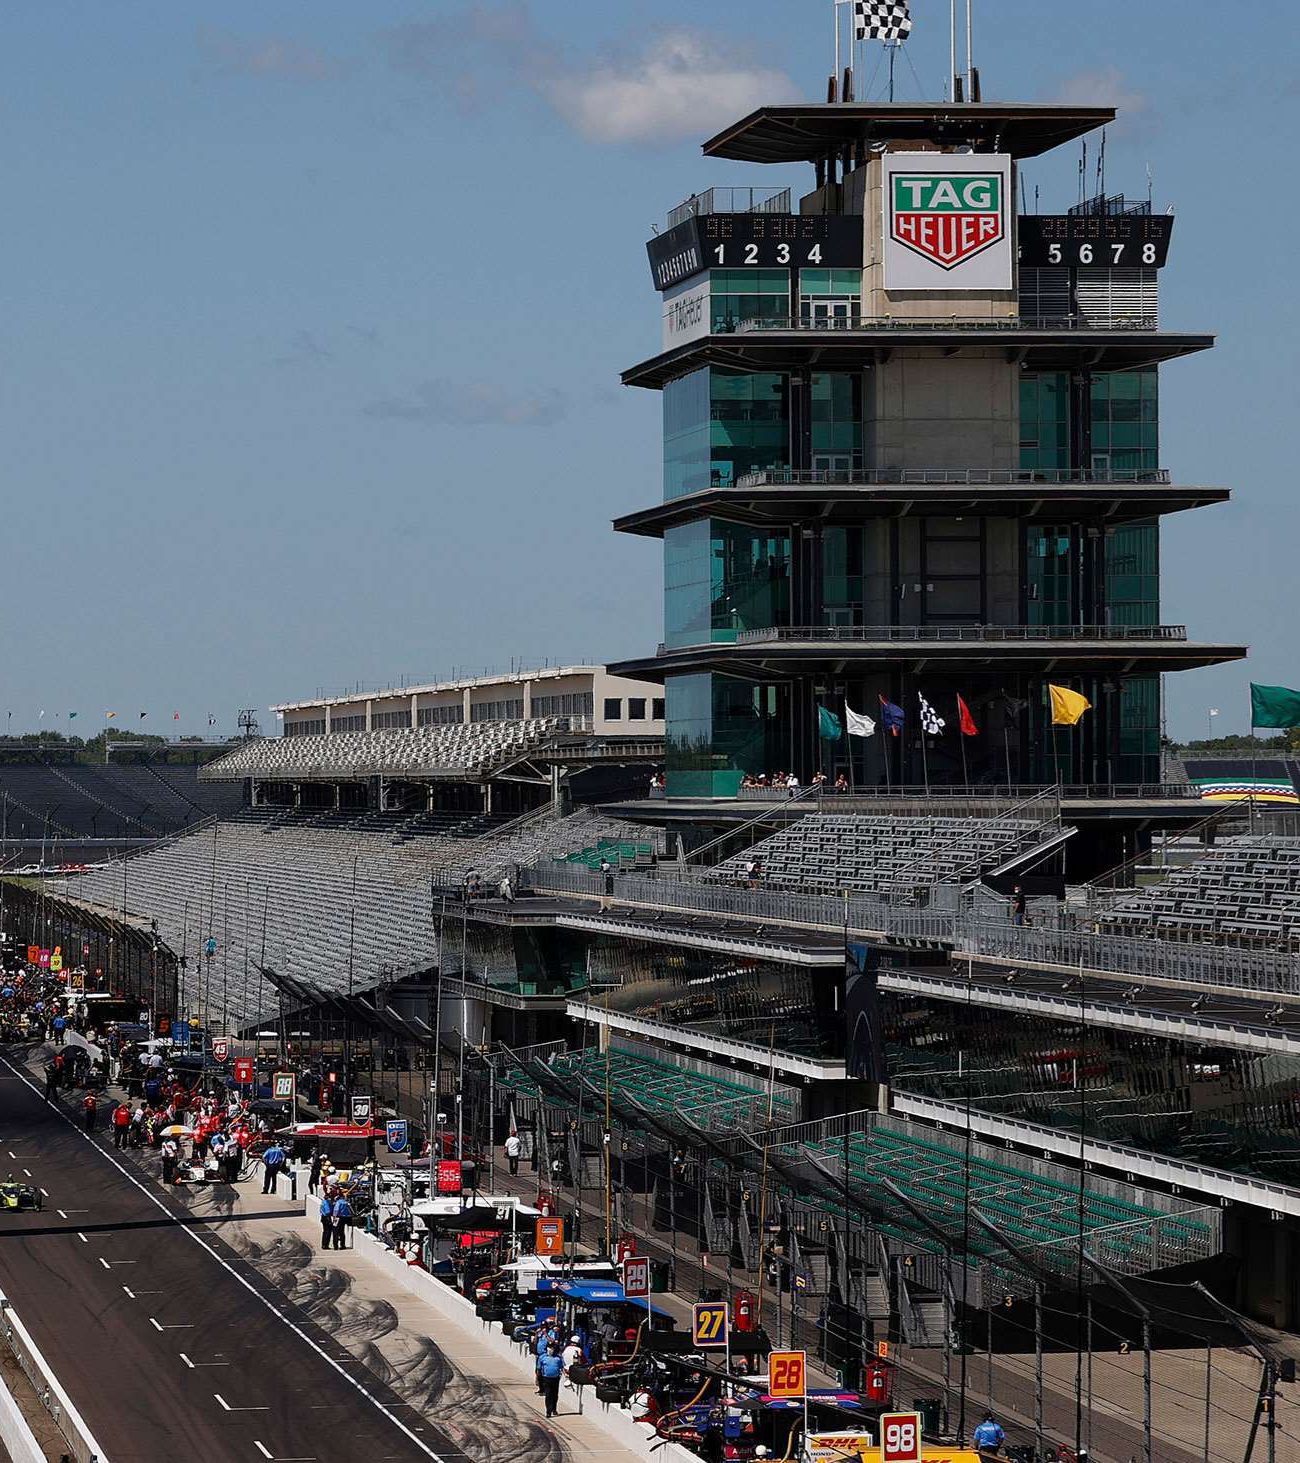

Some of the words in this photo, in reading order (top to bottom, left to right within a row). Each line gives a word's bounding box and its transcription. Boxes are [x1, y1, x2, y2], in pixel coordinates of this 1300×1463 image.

[901, 180, 991, 208] TAG
[899, 217, 995, 260] HEUER
[714, 243, 725, 264] 1
[744, 243, 758, 264] 2
[776, 243, 790, 264] 3
[807, 243, 822, 264] 4
[1048, 243, 1062, 264] 5
[1079, 243, 1093, 264] 6
[1111, 243, 1125, 264] 7
[1142, 243, 1156, 264] 8
[72, 975, 82, 987] 26
[215, 1044, 226, 1054] 45
[276, 1078, 292, 1095] 88
[354, 1104, 368, 1116] 30
[743, 1190, 749, 1200] 6
[820, 1221, 827, 1230] 5
[546, 1237, 553, 1248] 9
[904, 1256, 913, 1265] 4
[627, 1264, 647, 1291] 29
[1004, 1296, 1013, 1307] 3
[697, 1310, 725, 1339] 27
[1120, 1342, 1129, 1354] 2
[773, 1359, 802, 1390] 28
[1262, 1399, 1270, 1412] 1
[818, 1438, 859, 1448] DHL
[886, 1423, 915, 1452] 98
